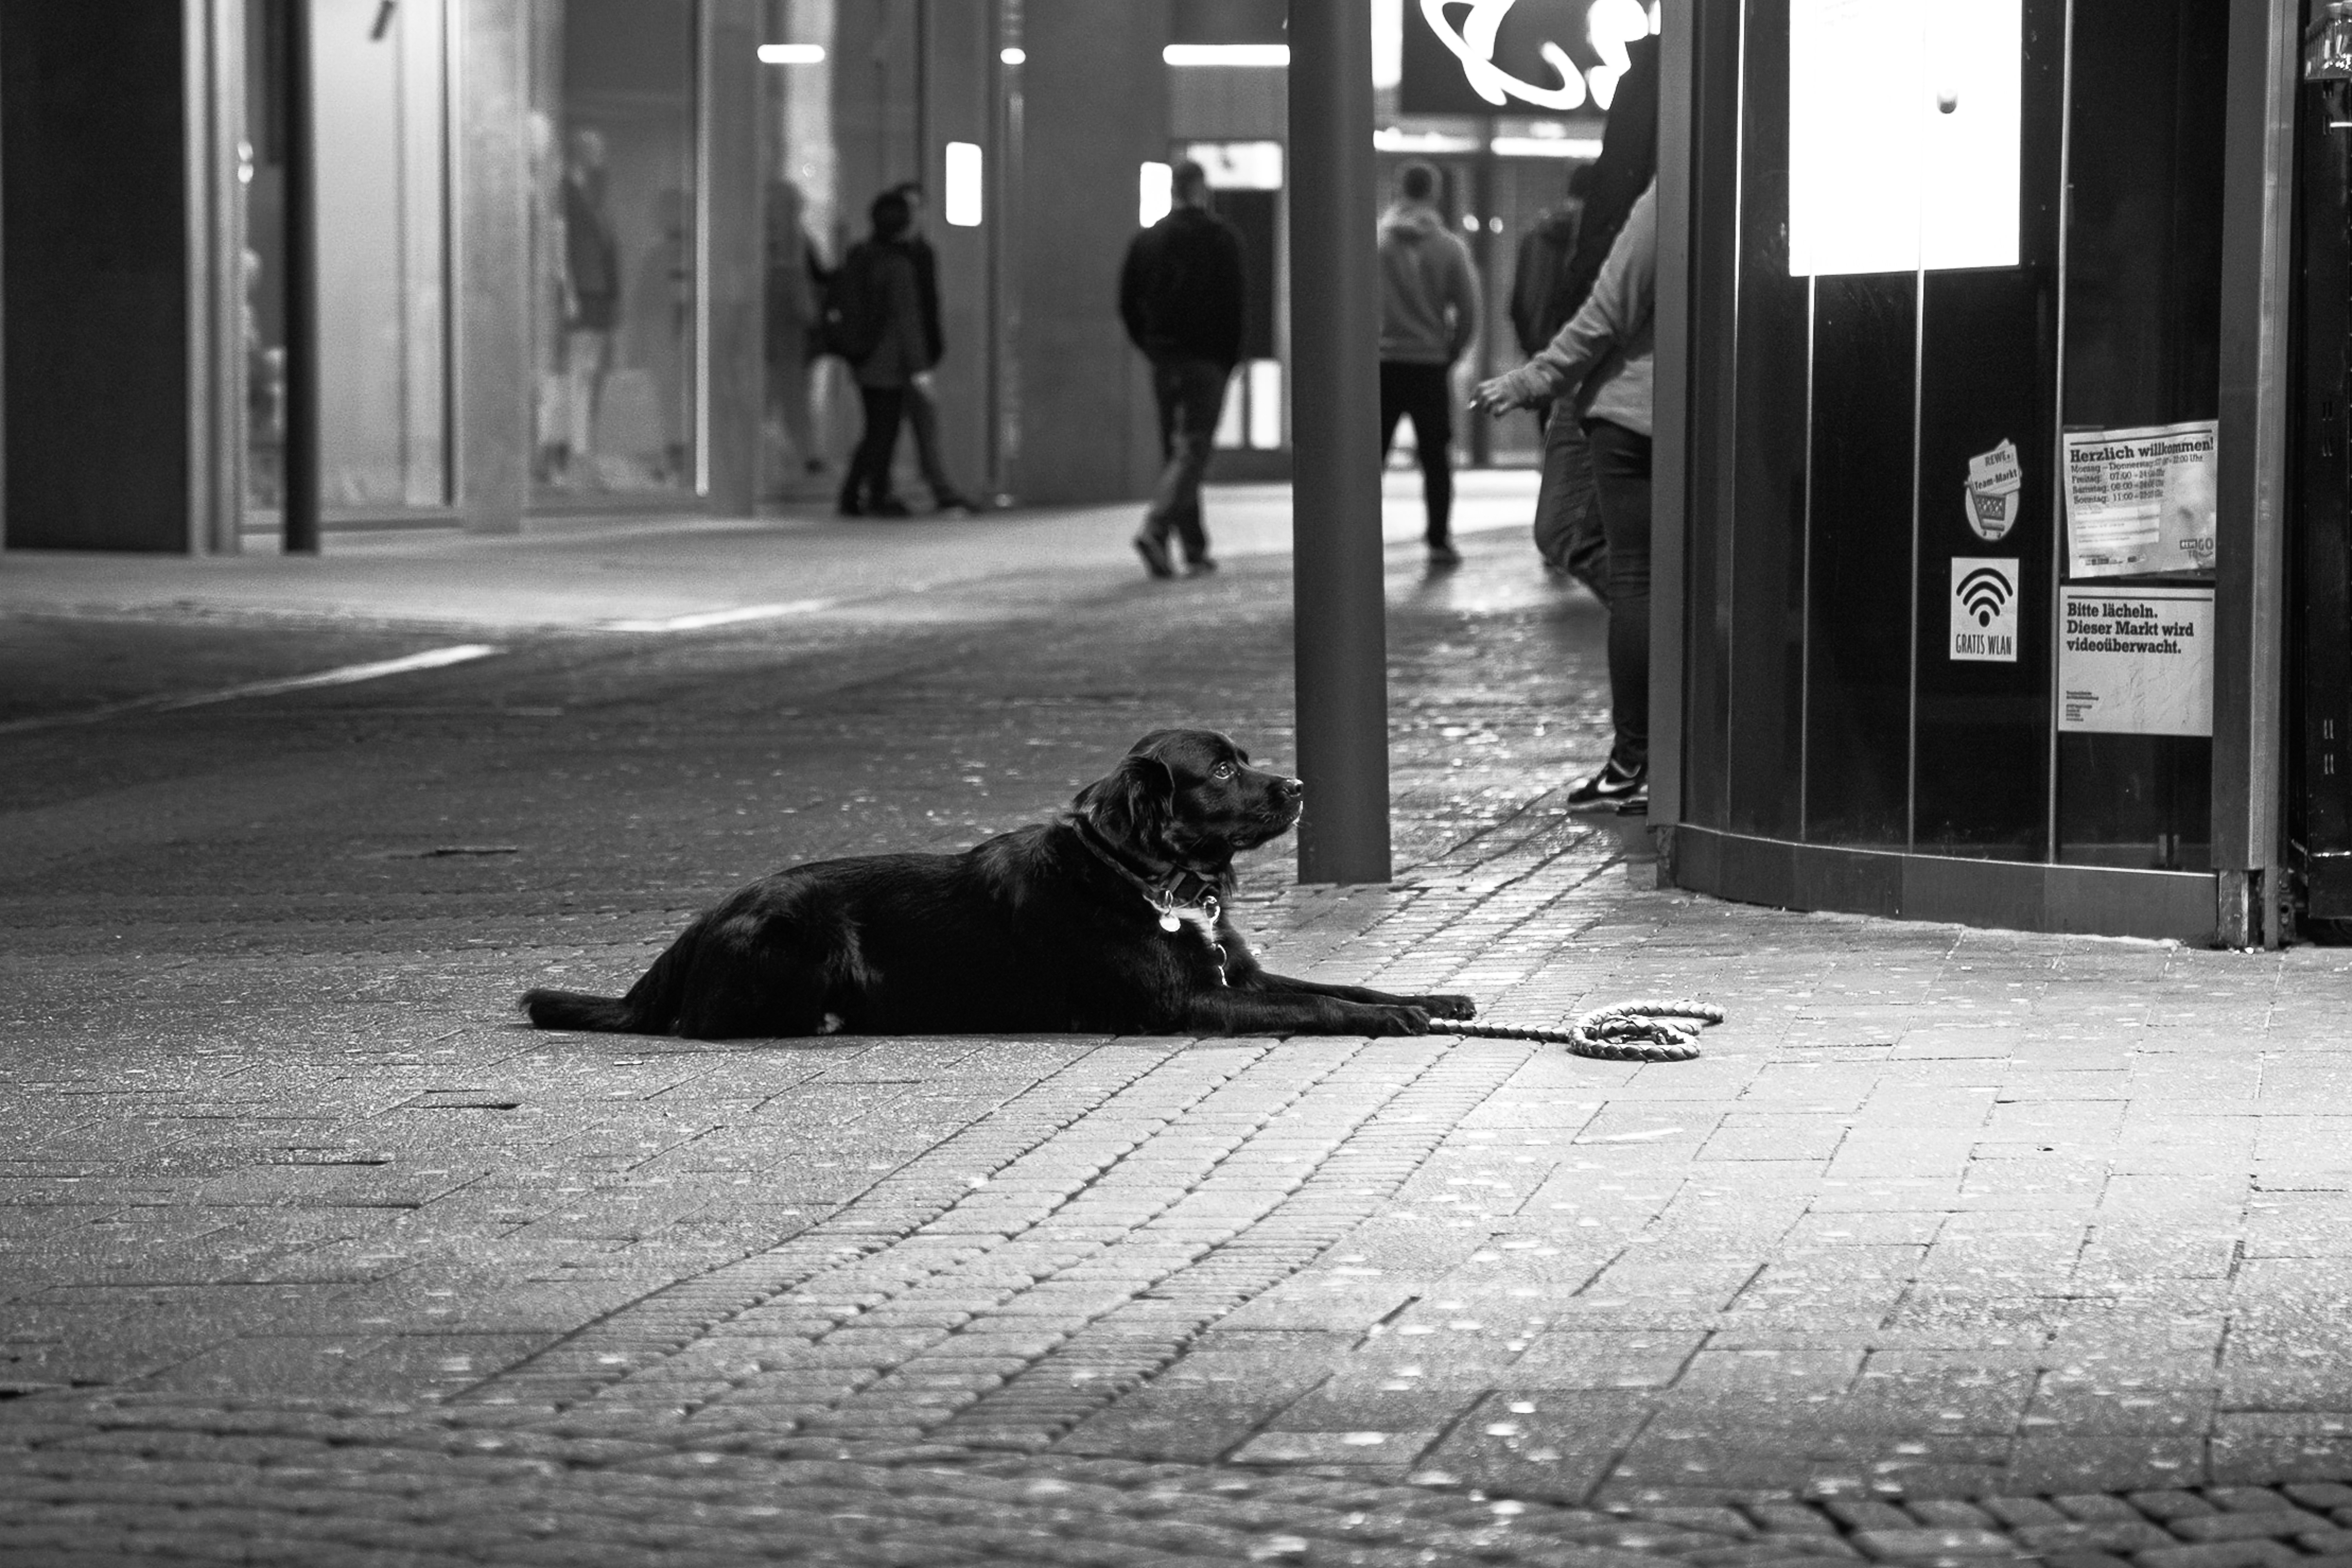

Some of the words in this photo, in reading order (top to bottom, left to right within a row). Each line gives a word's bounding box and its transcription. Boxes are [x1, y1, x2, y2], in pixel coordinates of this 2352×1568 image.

[2070, 445, 2135, 463] Herzlich
[2137, 436, 2214, 457] willkommen!
[2071, 464, 2101, 474] Montag
[2190, 453, 2203, 462] Uhr
[1974, 468, 2017, 490] Team-Markt
[2110, 471, 2132, 480] 07:00
[2113, 491, 2133, 502] 11:00
[2067, 602, 2099, 617] Bitte
[2102, 603, 2158, 618] lächeln.
[2066, 620, 2112, 635] Dieser
[2115, 621, 2159, 636] Markt
[2162, 622, 2194, 637] wird
[1956, 633, 1985, 655] GRATIS
[1988, 634, 2012, 655] WLAN
[2066, 637, 2181, 654] videoüberwacht.
